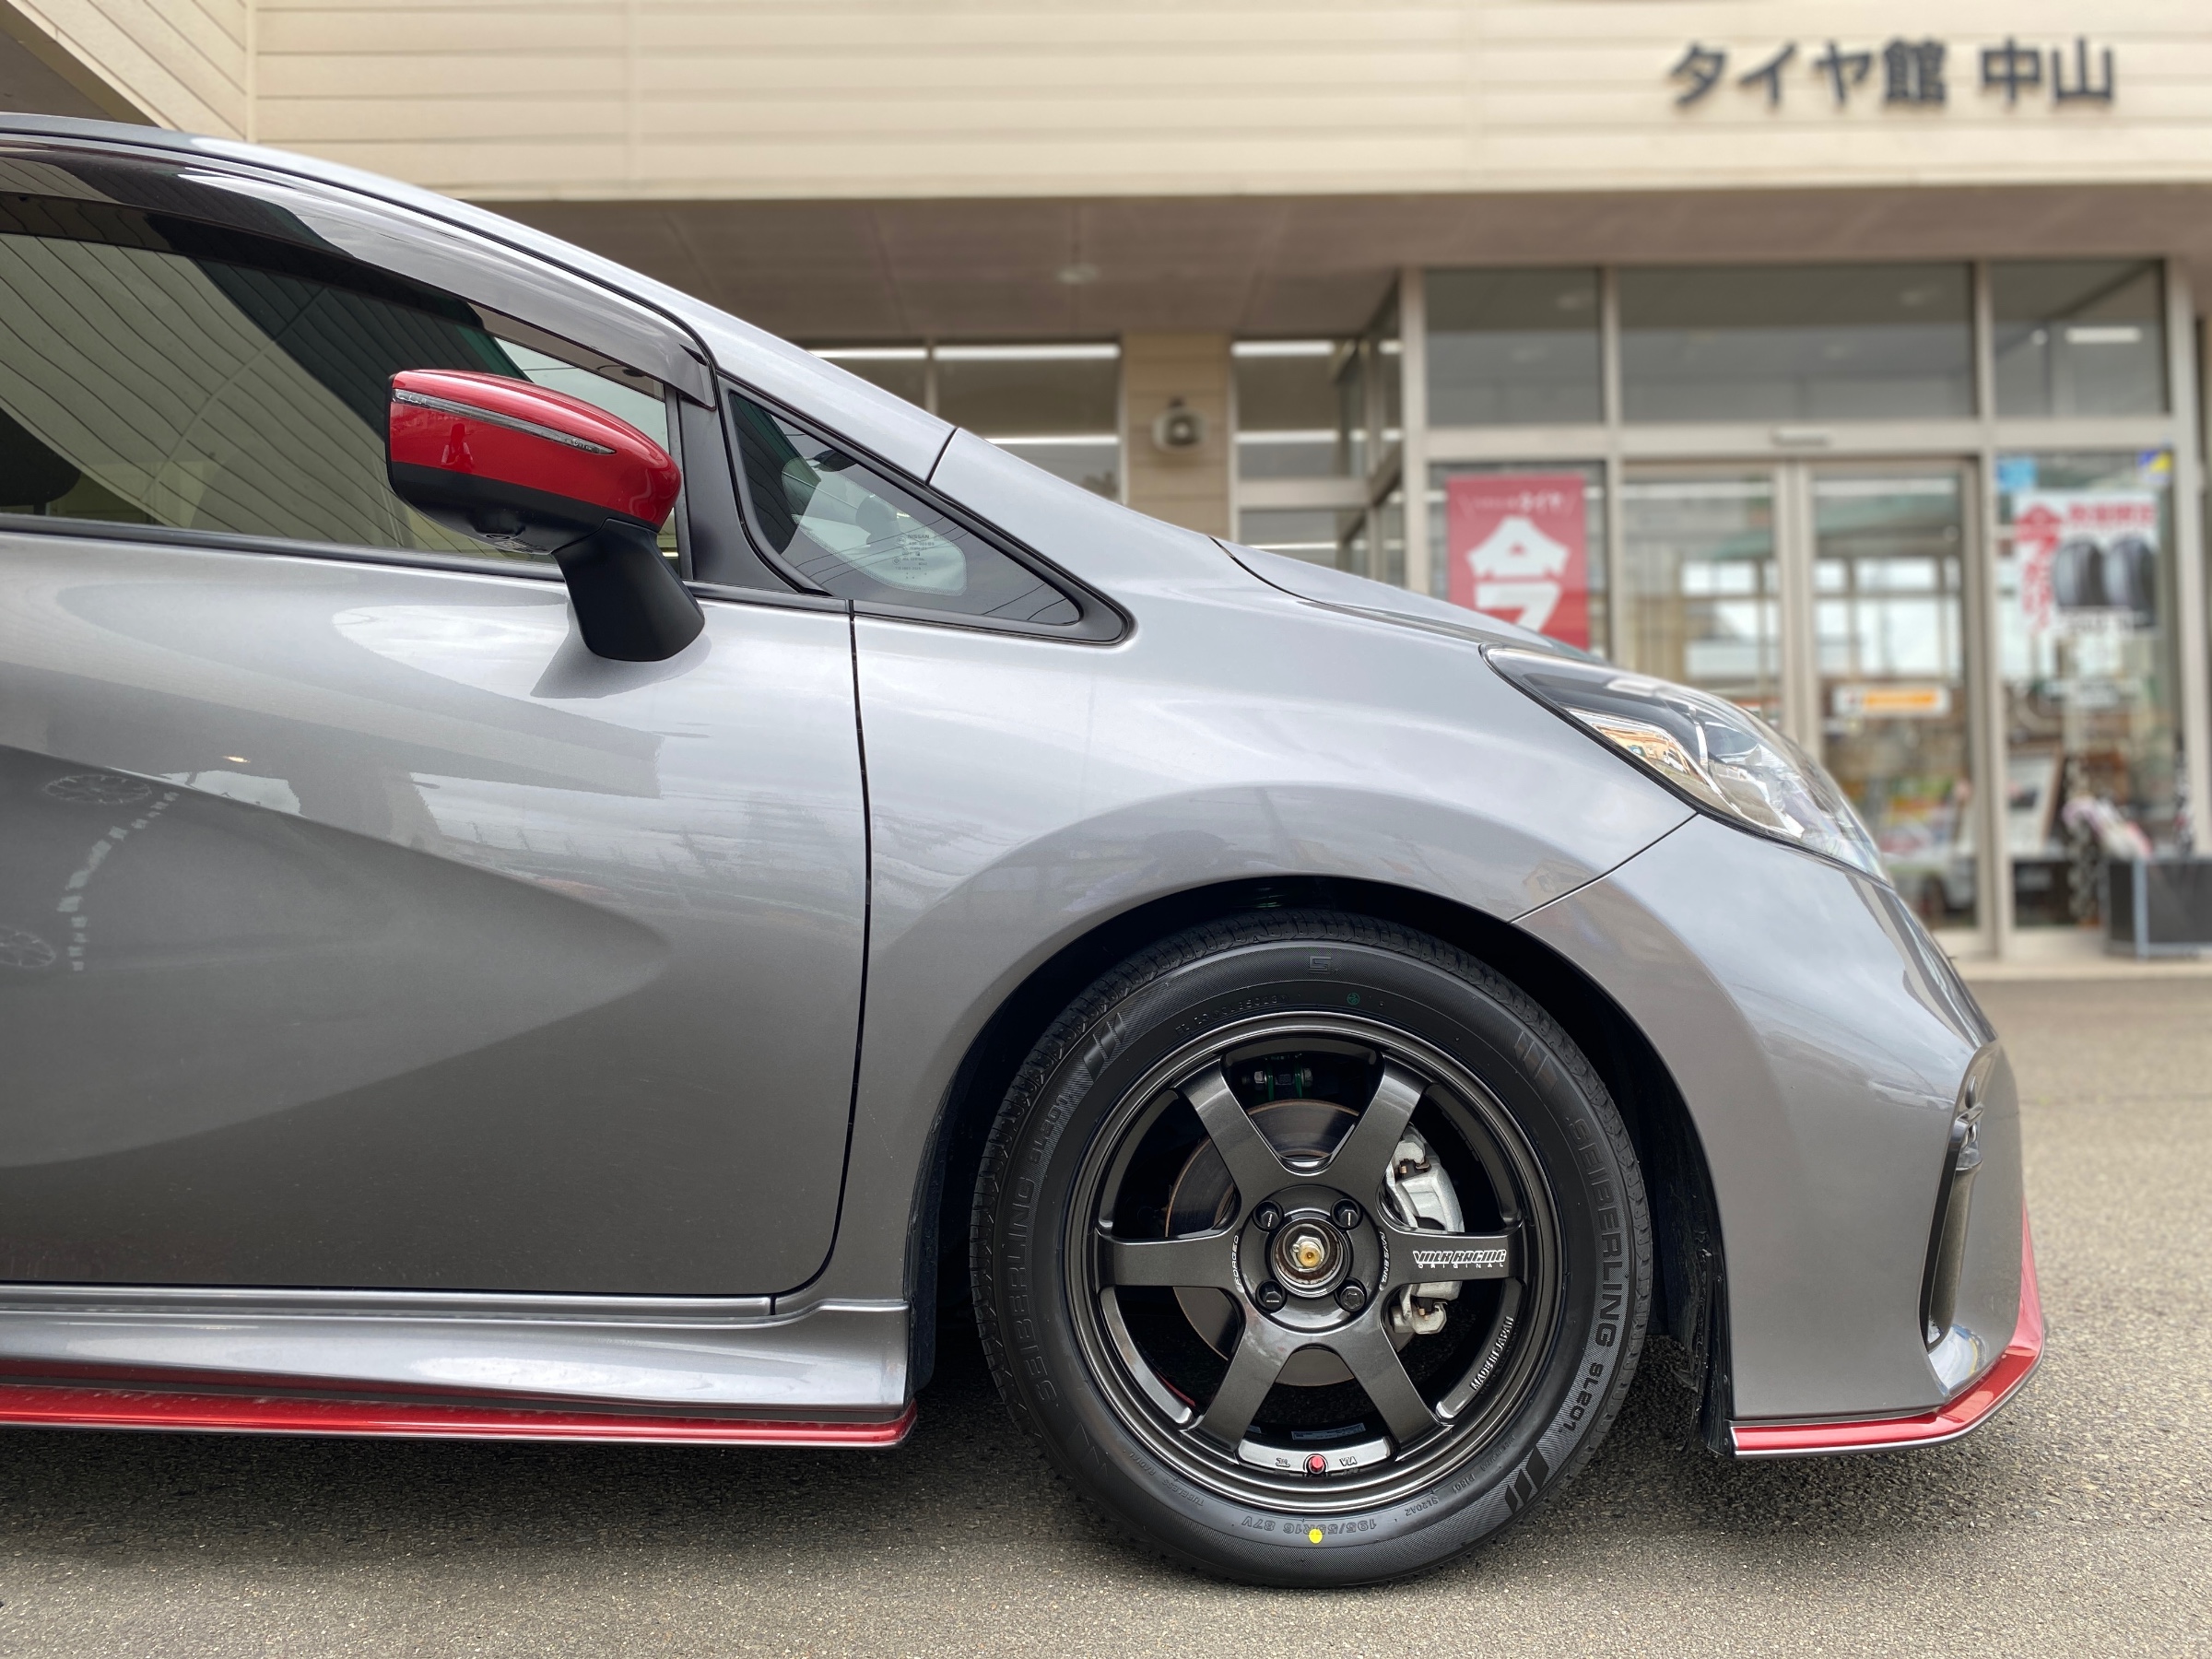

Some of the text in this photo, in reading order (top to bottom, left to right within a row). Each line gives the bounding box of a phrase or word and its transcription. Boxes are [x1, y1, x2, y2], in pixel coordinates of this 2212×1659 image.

[1668, 35, 2113, 106] タイヤ館 中山
[1569, 1118, 1625, 1347] SEIBERLING
[1231, 1234, 1241, 1286] FORGED
[1451, 1248, 1507, 1264] RACING
[1006, 1176, 1058, 1402] SEIBERLING
[1470, 1362, 1493, 1392] MADE
[1496, 1315, 1514, 1352] JAPAN
[1127, 1450, 1158, 1477] RADIAL
[1338, 1455, 1358, 1467] VIA
[1160, 1477, 1205, 1508] TUBELESS
[1241, 1515, 1377, 1535] 195/55R16 87V
